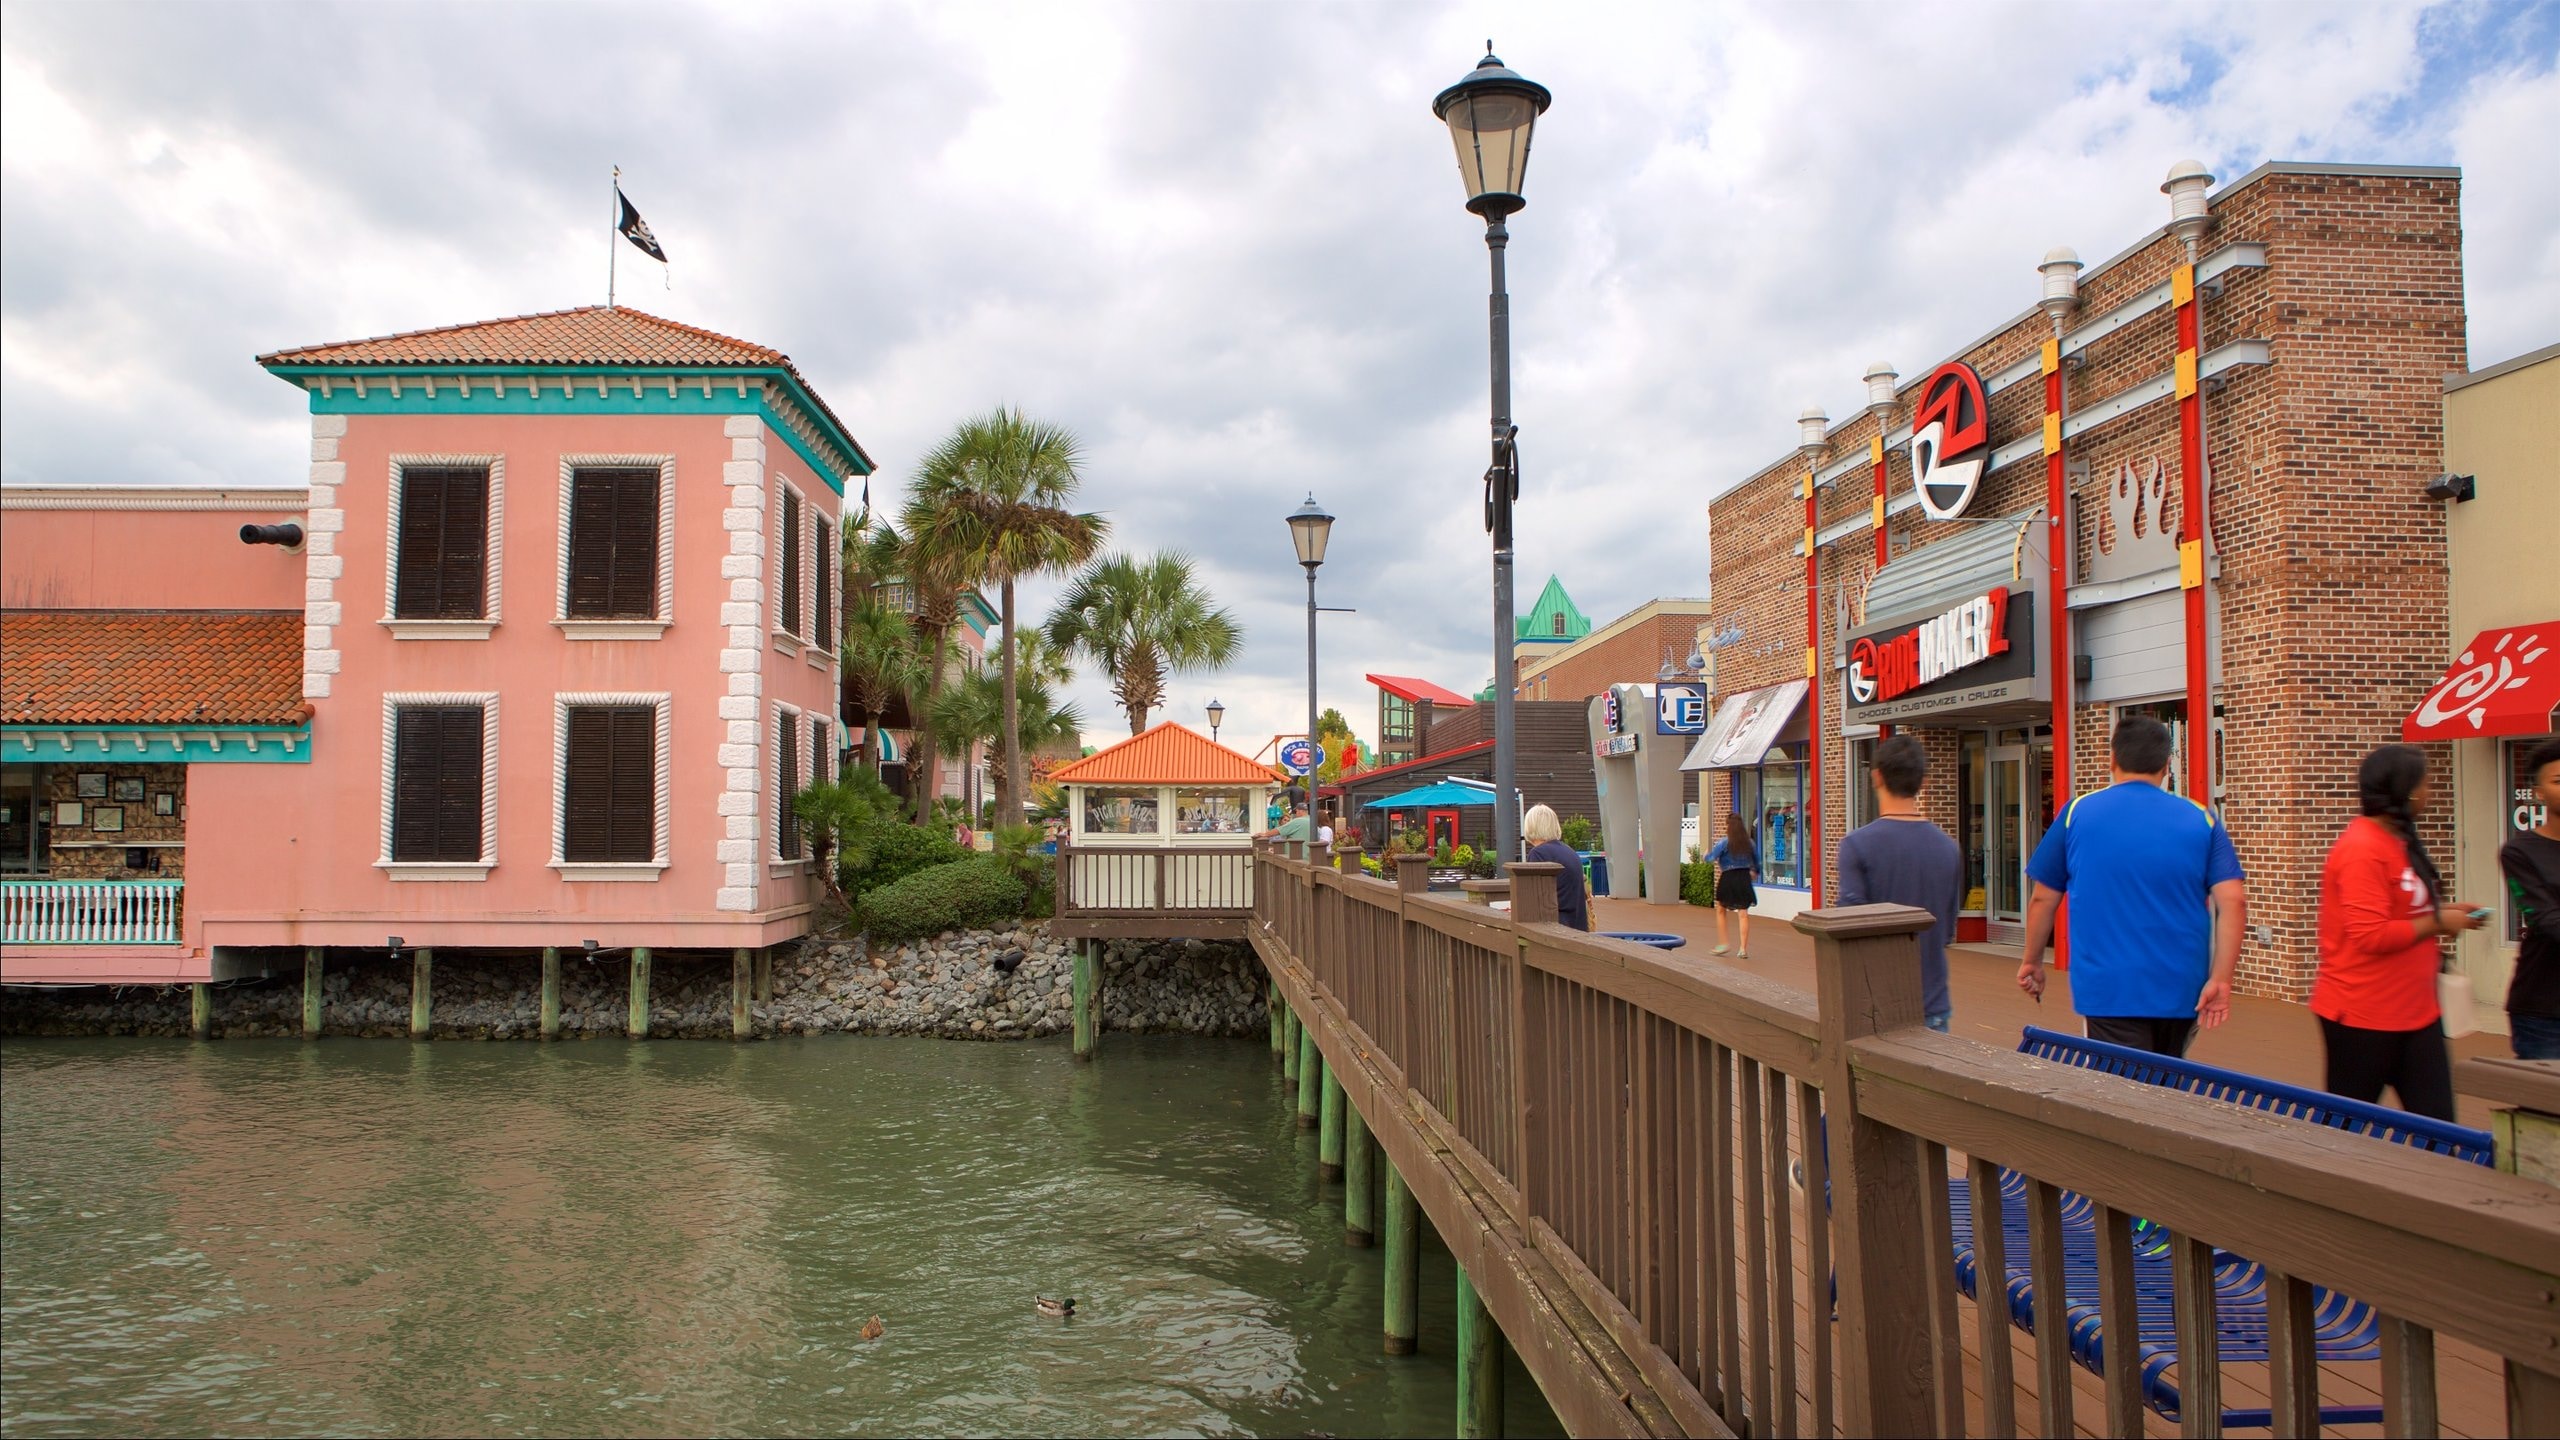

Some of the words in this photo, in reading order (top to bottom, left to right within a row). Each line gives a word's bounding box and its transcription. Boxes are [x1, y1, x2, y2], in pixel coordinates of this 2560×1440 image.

[1878, 585, 2009, 702] RIDEMAKERZ
[1858, 707, 1892, 719] CHOOZE
[1901, 697, 1957, 712] CUSTOMIZE
[1967, 688, 2007, 701] CRUIZE
[2514, 788, 2532, 800] SEE
[1091, 804, 1115, 822] PICK
[2513, 805, 2547, 831] CH
[1777, 876, 1795, 886] DIESEL
